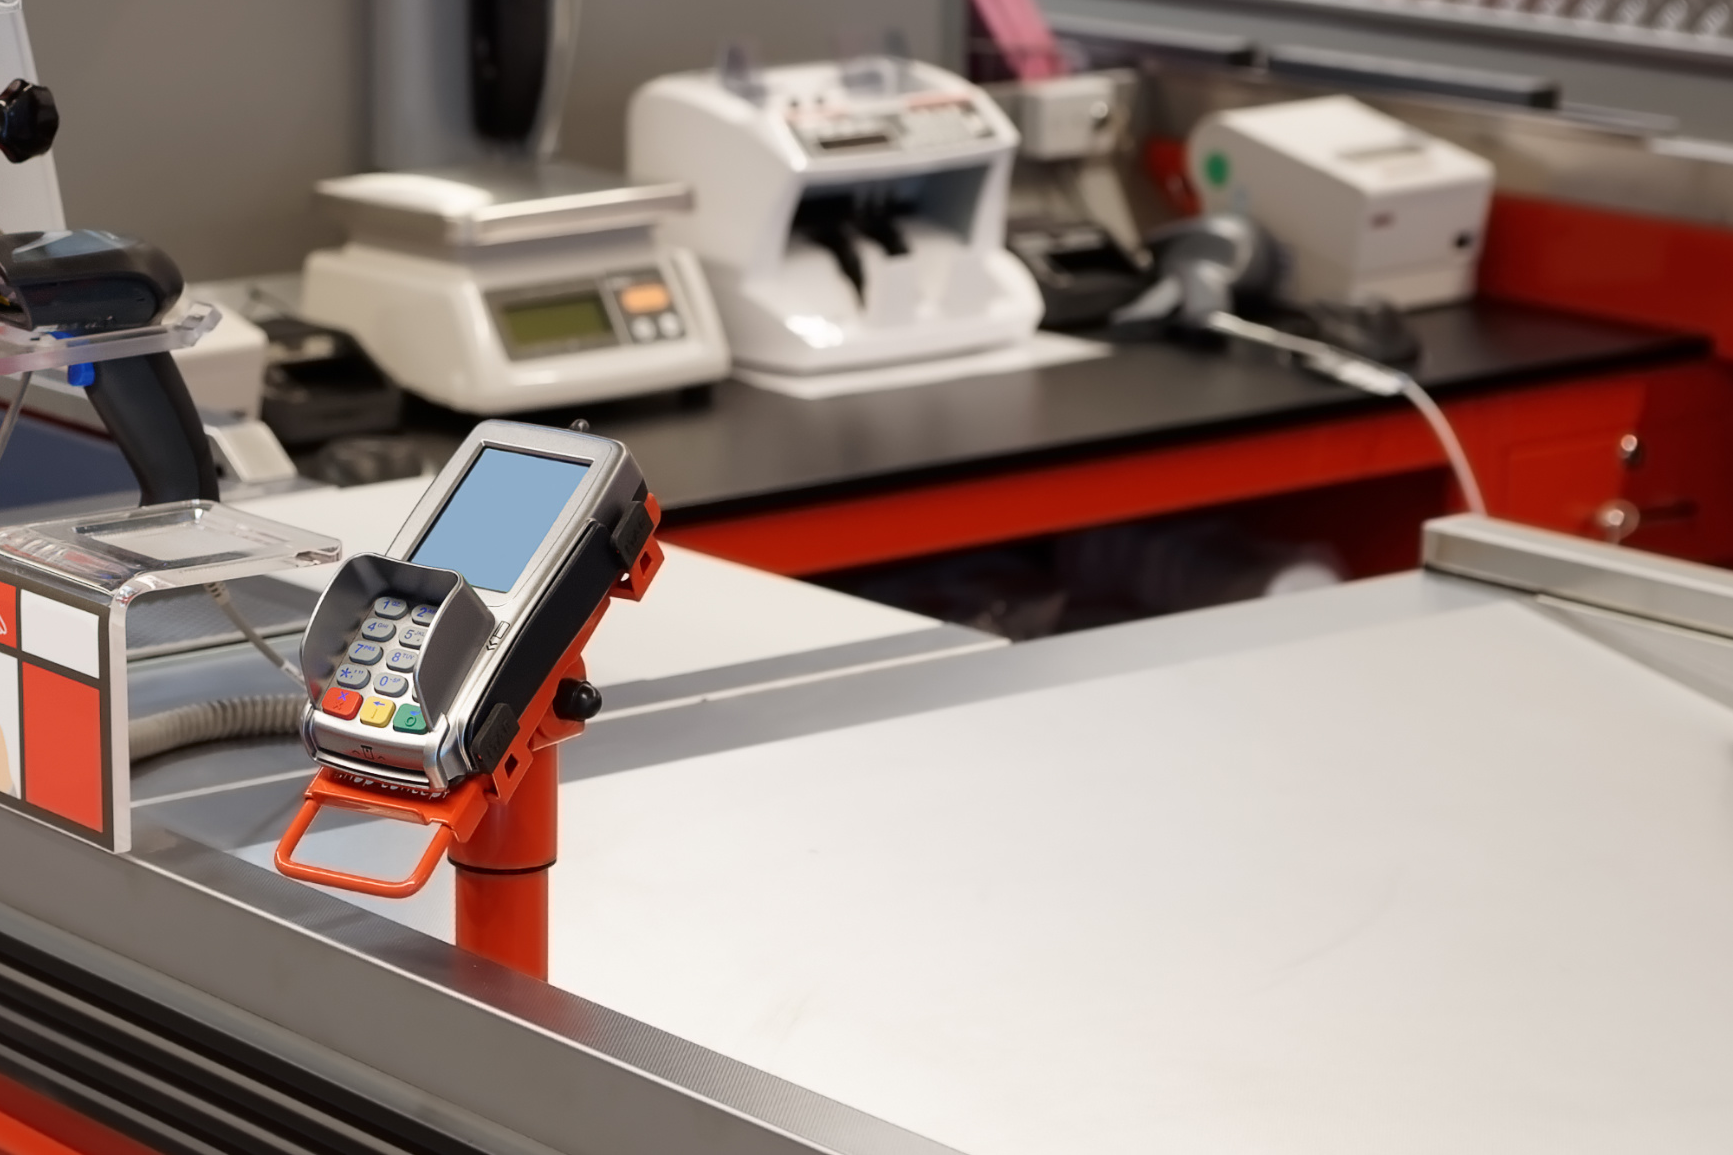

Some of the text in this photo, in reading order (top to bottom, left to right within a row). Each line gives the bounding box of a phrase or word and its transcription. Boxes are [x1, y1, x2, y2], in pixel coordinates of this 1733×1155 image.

[383, 600, 390, 610] 1
[417, 607, 428, 617] 2
[367, 621, 377, 632] 4
[404, 629, 415, 639] 5
[354, 643, 364, 654] 7
[391, 652, 401, 662] 8
[379, 675, 389, 687] 0
